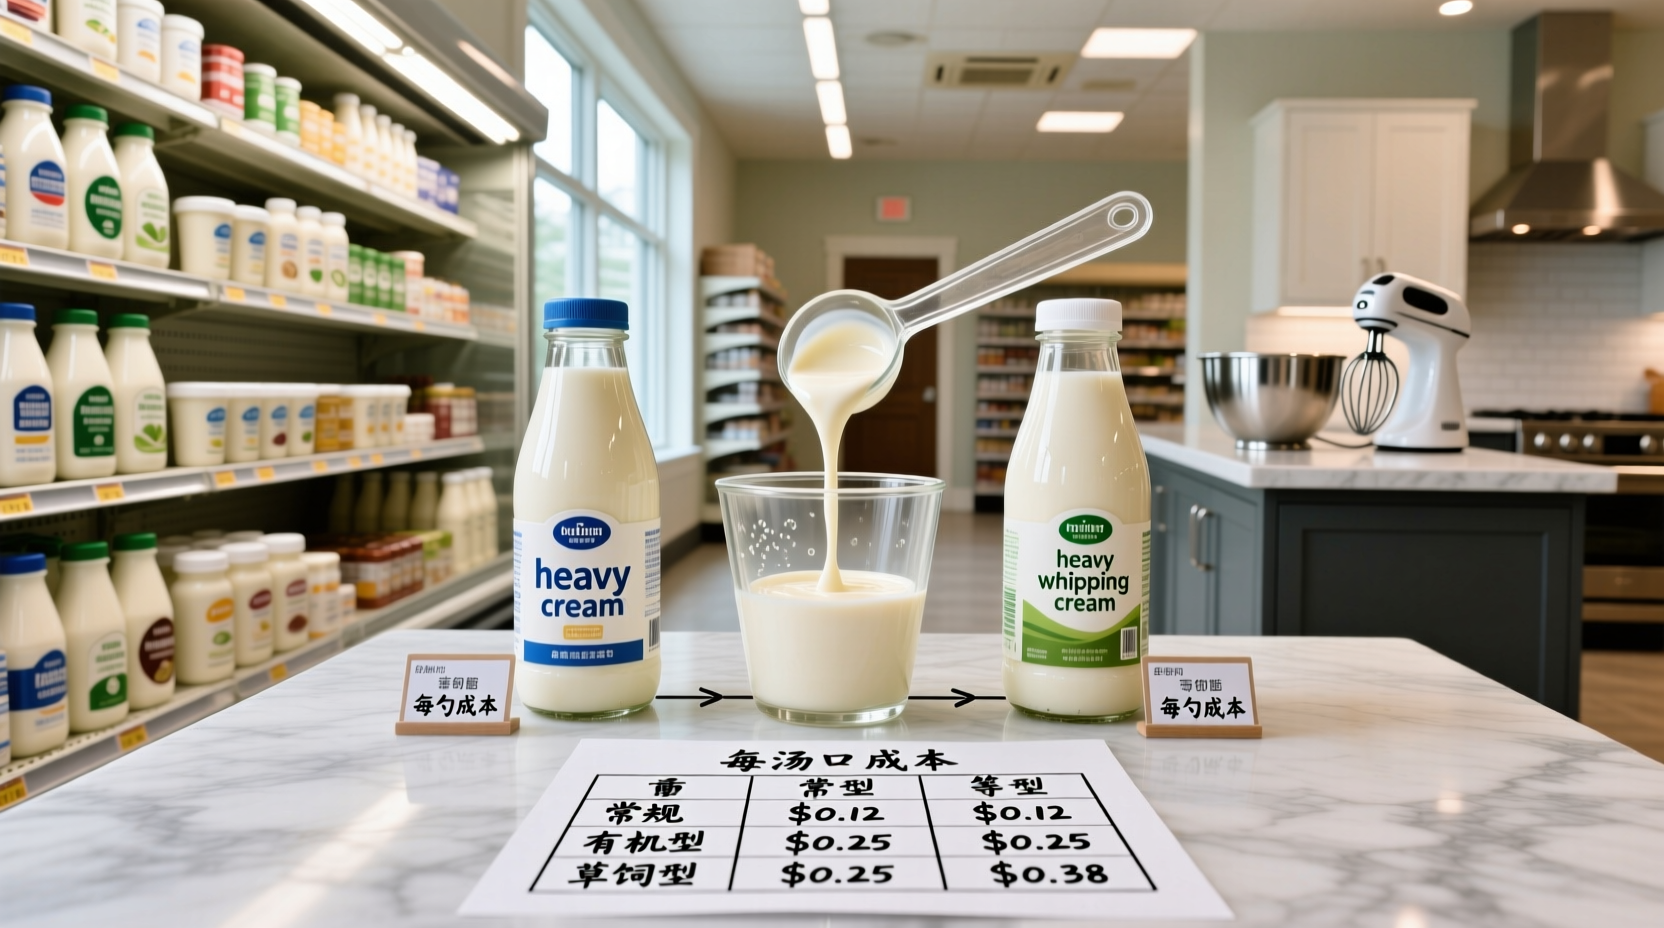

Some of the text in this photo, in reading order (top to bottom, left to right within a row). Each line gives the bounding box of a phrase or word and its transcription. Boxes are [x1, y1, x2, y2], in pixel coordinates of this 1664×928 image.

[1057, 549, 1114, 572] heavy
[536, 557, 631, 597] heavy
[1038, 572, 1129, 595] whipping
[541, 598, 624, 617] cream
[1054, 597, 1116, 612] cream
[413, 694, 498, 718] 每勺成本
[1160, 696, 1246, 720] 每勺成本
[720, 749, 958, 772] 每汤口成本
[605, 801, 684, 824] 常规
[788, 802, 885, 825] $0.12
[973, 801, 1072, 825] $0.12
[583, 830, 705, 855] 有机型
[785, 830, 892, 855] $0.25
[981, 829, 1091, 856] $0.25
[568, 861, 697, 889] 草饲型
[782, 861, 894, 888] $0.25
[990, 860, 1109, 888] $0.38
